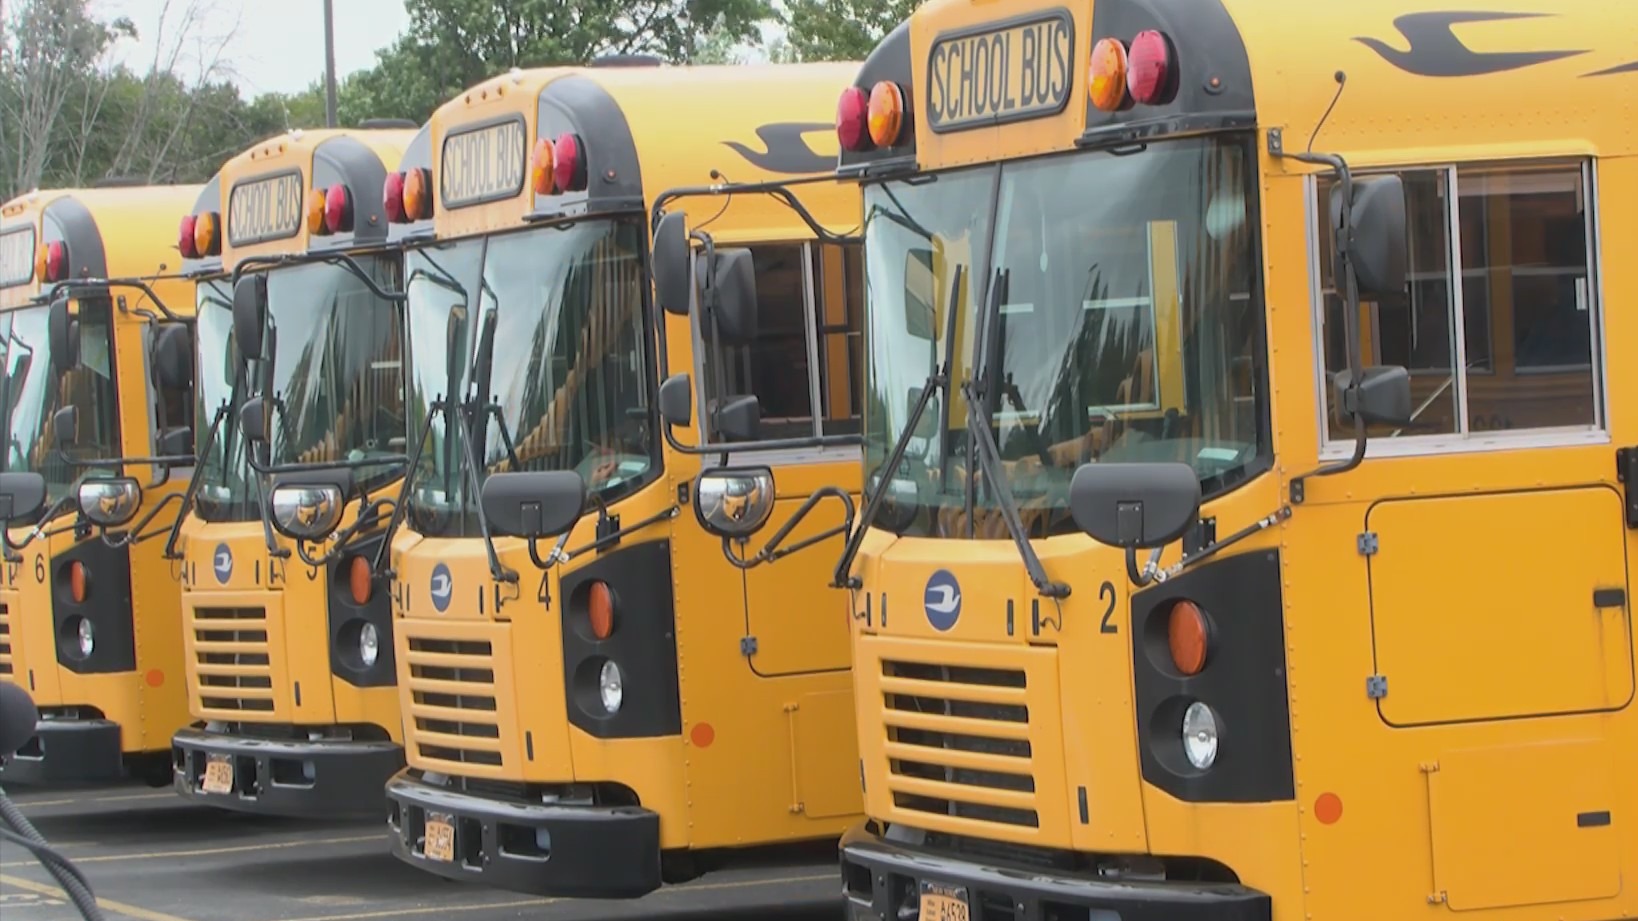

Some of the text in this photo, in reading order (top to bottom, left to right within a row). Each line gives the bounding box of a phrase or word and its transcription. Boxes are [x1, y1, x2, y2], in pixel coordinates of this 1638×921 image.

[932, 21, 1067, 122] SCHOOL BUS
[443, 124, 524, 199] SCHOOL BUS
[230, 175, 301, 237] SCHOOL BUS
[35, 552, 45, 584] 6
[306, 545, 318, 581] 5
[537, 570, 551, 612] 4
[1099, 580, 1118, 634] 2
